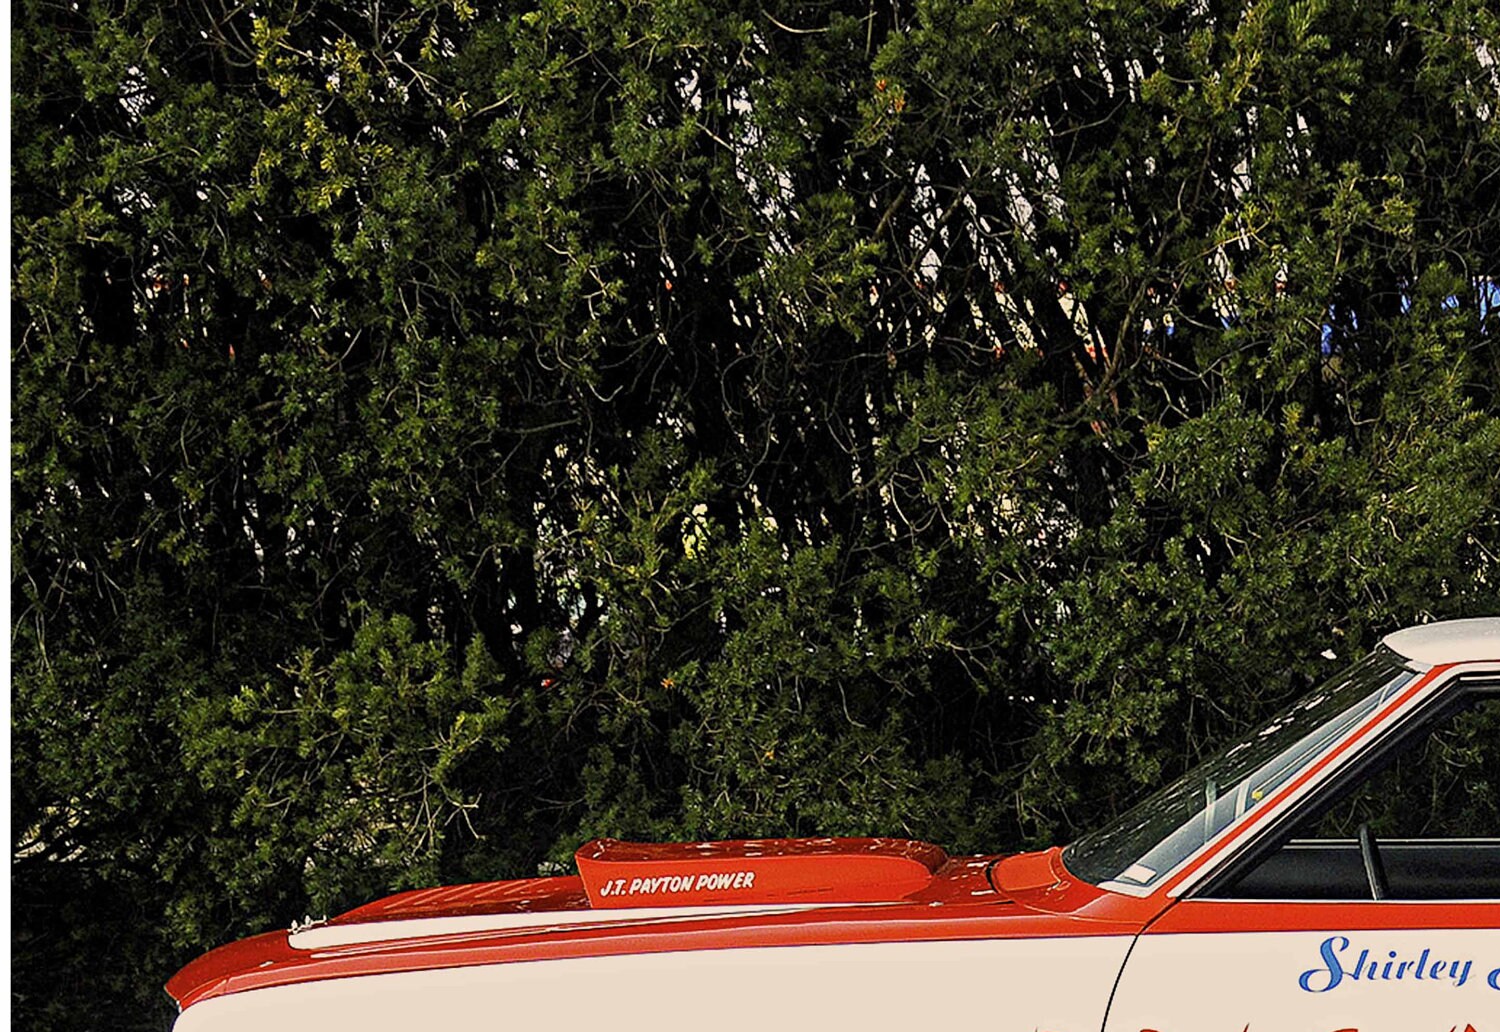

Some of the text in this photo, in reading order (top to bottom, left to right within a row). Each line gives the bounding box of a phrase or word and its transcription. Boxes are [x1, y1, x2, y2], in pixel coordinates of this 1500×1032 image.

[600, 871, 755, 897] J.T. PAYTON POWER
[1299, 935, 1475, 993] Shirley
